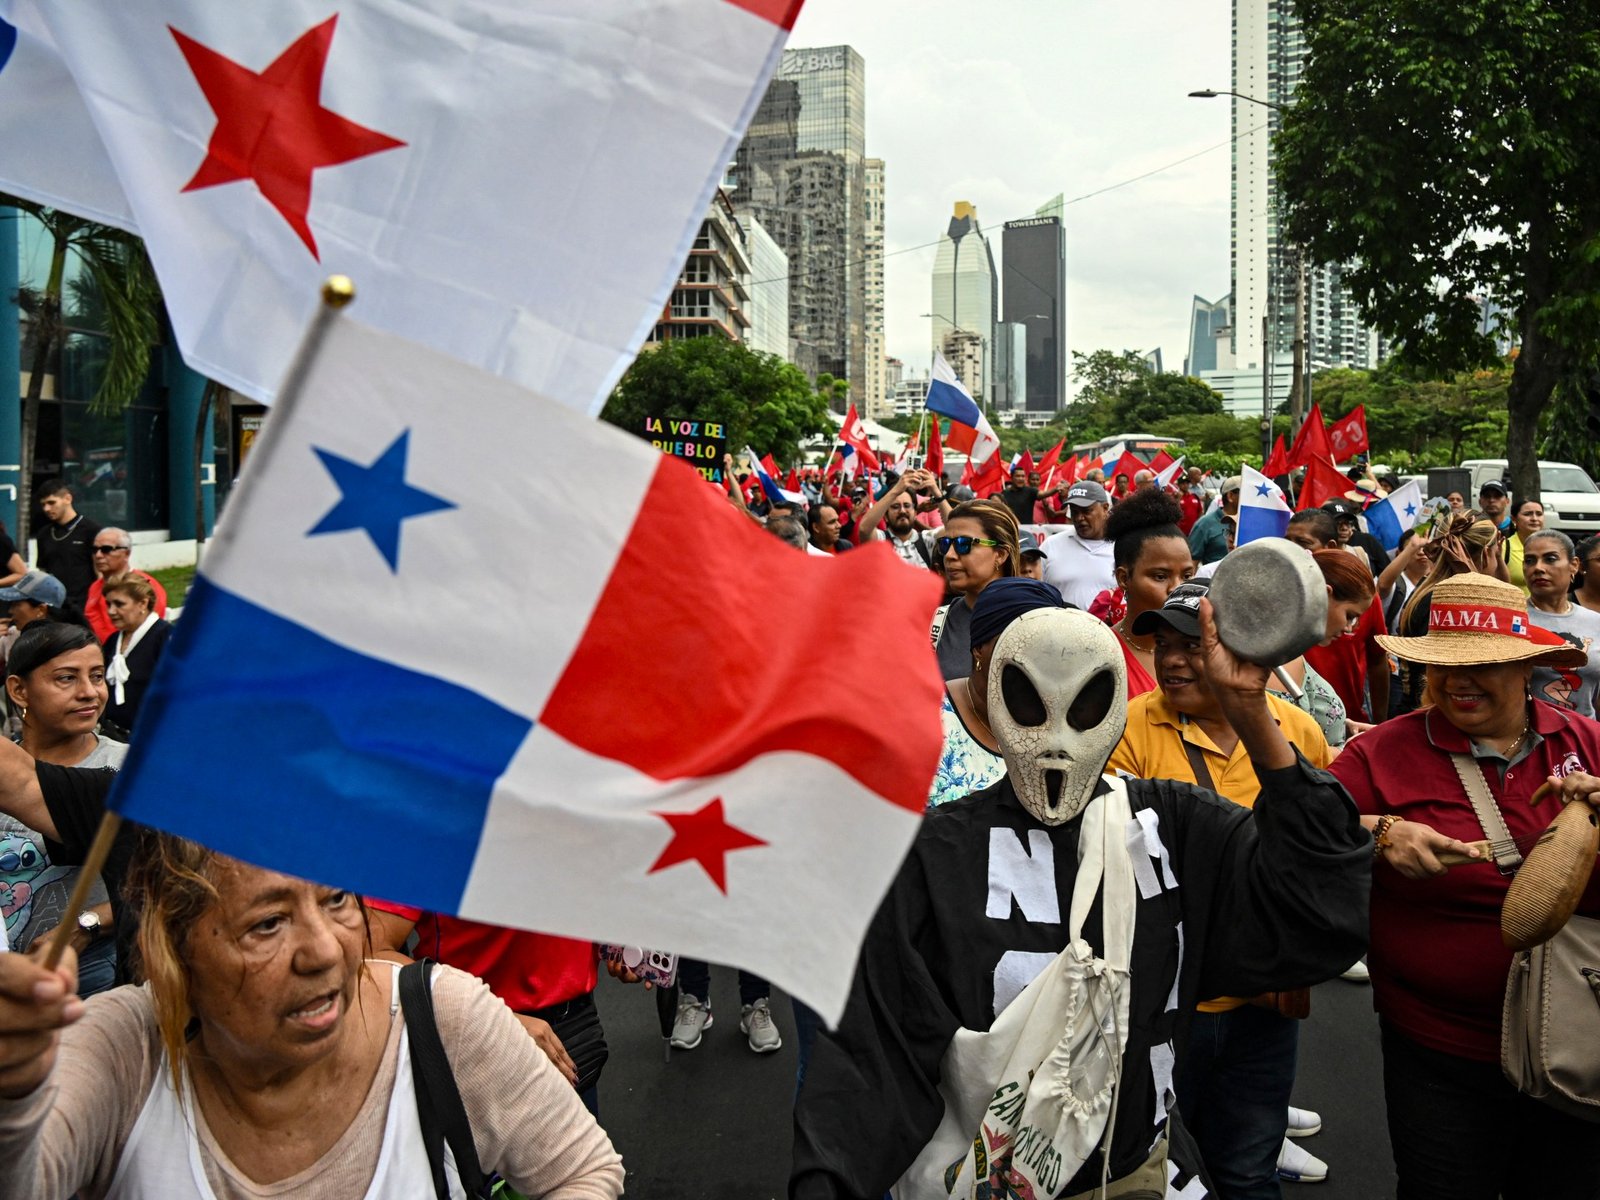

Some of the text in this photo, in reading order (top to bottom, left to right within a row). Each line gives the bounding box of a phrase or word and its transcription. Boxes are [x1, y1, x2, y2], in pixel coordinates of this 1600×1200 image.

[808, 53, 843, 71] BAC
[1008, 218, 1054, 229] TOWERBANK
[646, 417, 726, 439] LA VOZ DEL
[652, 440, 716, 459] PUEBLO
